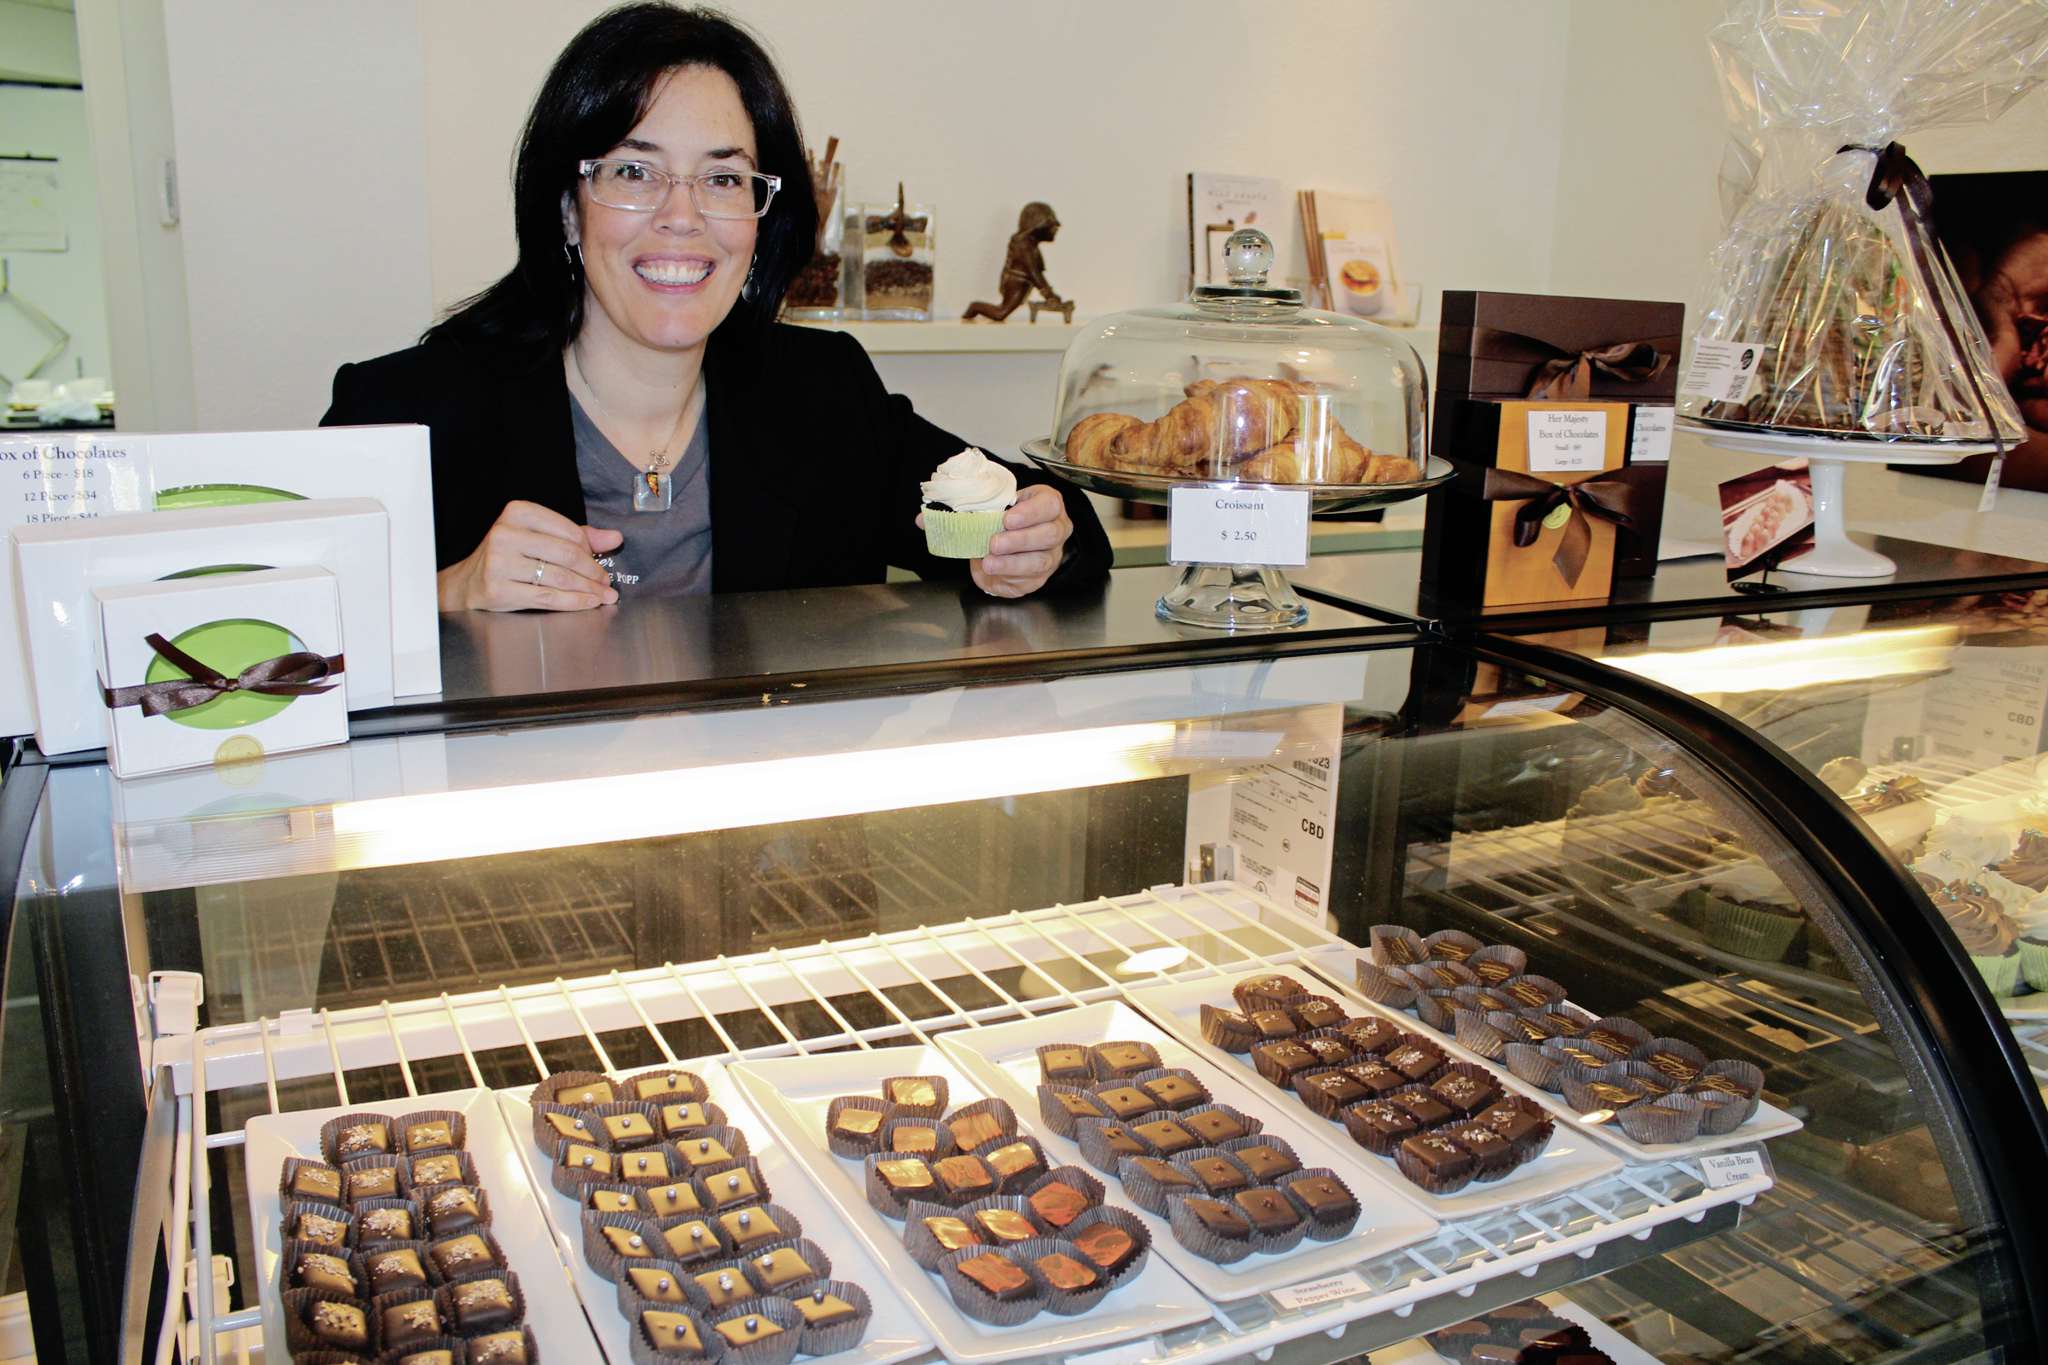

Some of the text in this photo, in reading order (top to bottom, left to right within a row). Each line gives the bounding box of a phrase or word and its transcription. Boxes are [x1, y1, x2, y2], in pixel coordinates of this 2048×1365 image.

[1547, 413, 1589, 425] Her Majesty
[1539, 428, 1553, 439] Box
[1563, 428, 1600, 439] Chocolates
[22, 445, 39, 460] of
[42, 445, 127, 460] Chocolates
[23, 471, 30, 480] 6
[33, 469, 62, 479] Pece
[24, 492, 36, 502] 12
[1215, 499, 1264, 511] Croissant
[26, 513, 39, 524] 18
[1221, 530, 1257, 541] $ 2.50
[2007, 711, 2034, 727] CBD
[1301, 818, 1325, 840] CBD
[1709, 1155, 1754, 1168] Vanilla Bean
[1726, 1171, 1749, 1181] Cream
